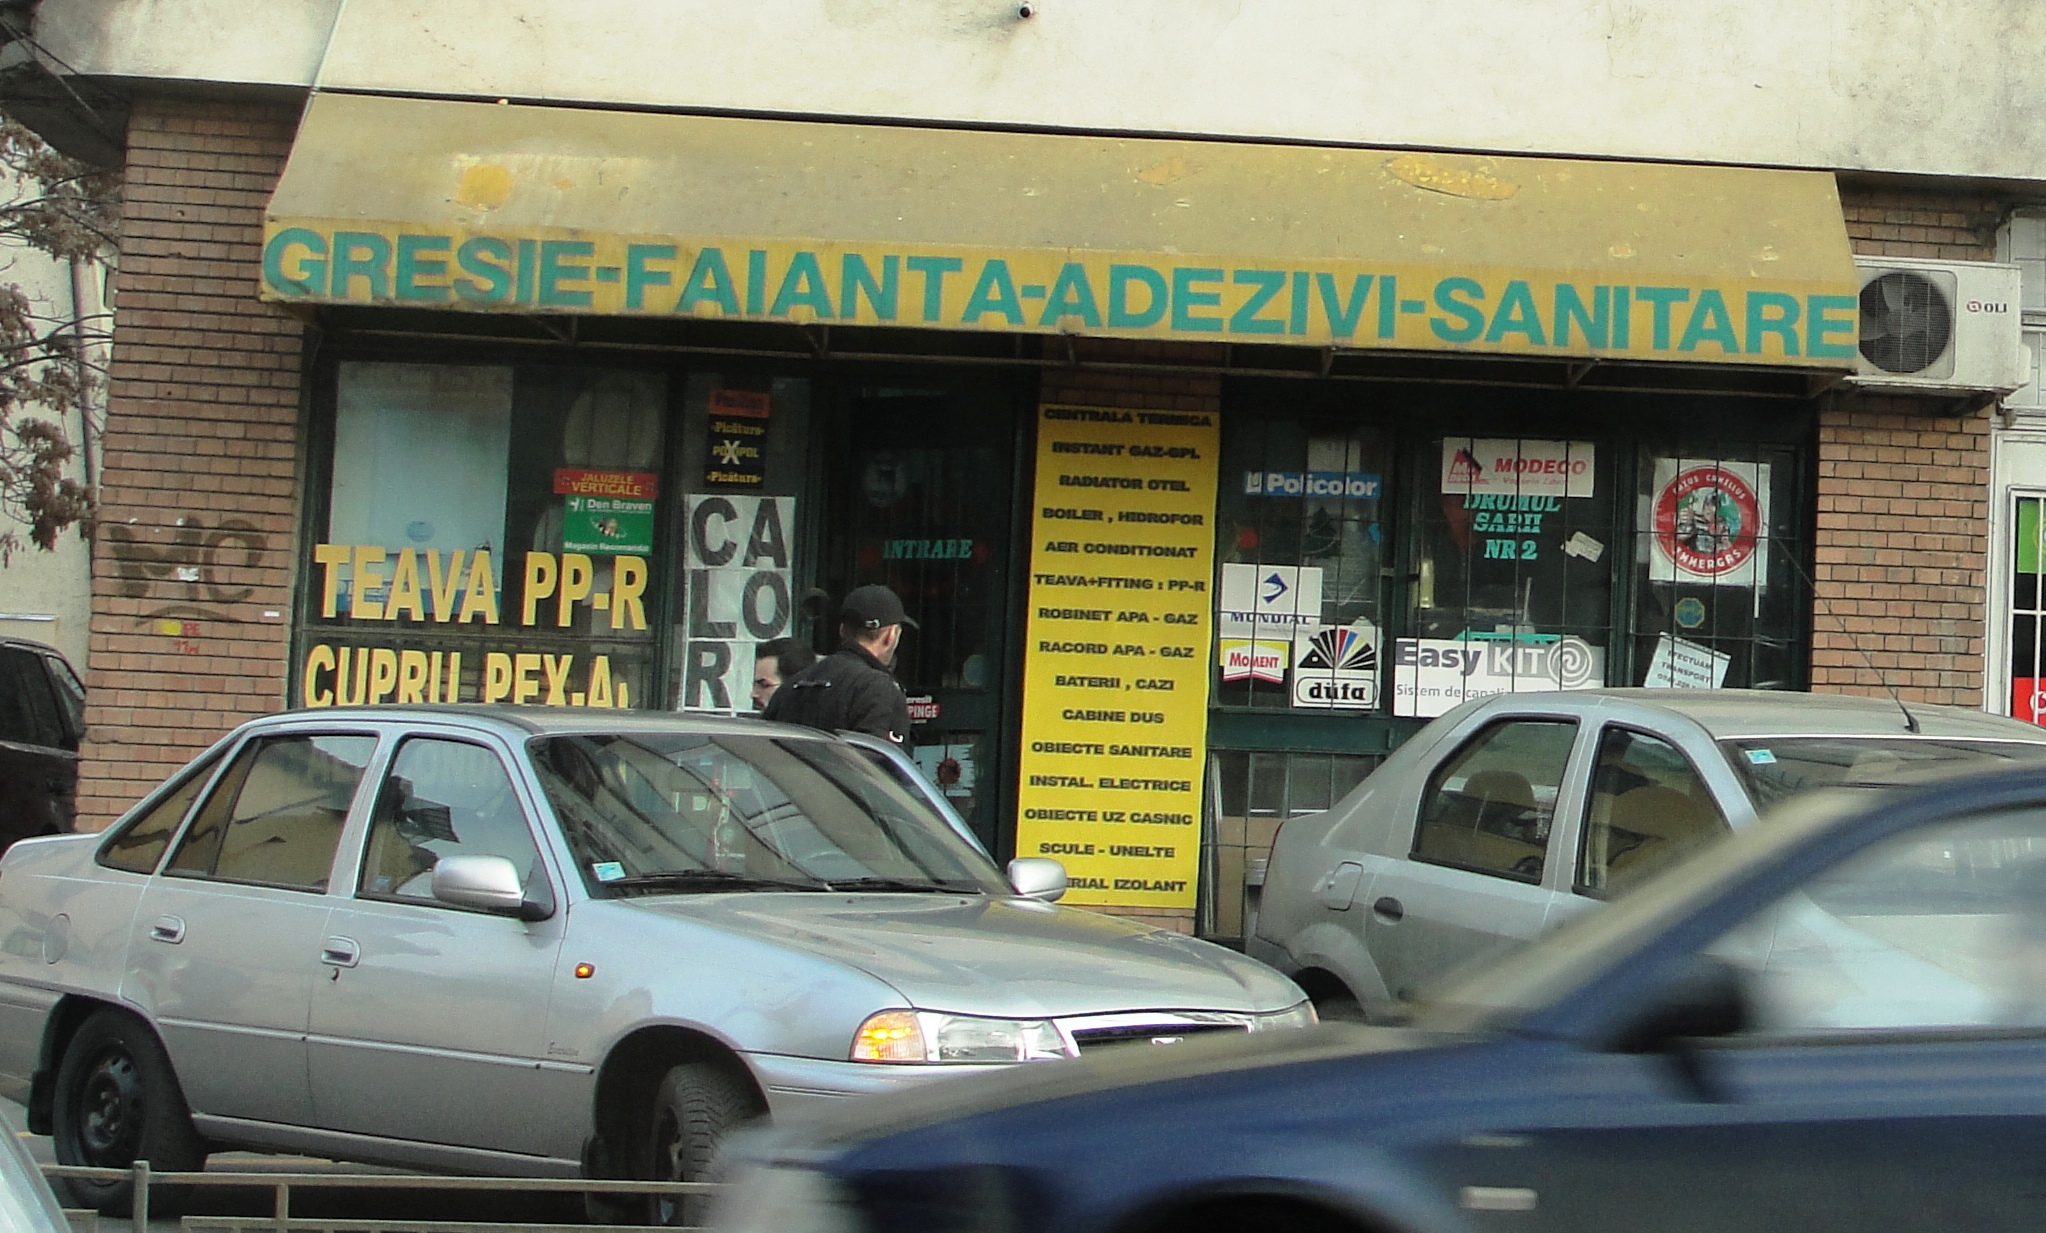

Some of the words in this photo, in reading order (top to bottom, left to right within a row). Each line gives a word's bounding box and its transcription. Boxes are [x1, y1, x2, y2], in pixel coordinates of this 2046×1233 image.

[262, 227, 1858, 358] GRESIE-FAIANTA-ADEZIVI-SANITARE
[1052, 442, 1126, 456] INSTANT
[1494, 458, 1587, 475] MODECO
[581, 473, 634, 485] JALUZELE
[1059, 475, 1143, 490] RADIATOR
[1148, 479, 1190, 492] OTEL
[1267, 473, 1377, 496] Policolor
[571, 481, 642, 495] VERTICALE
[1042, 508, 1104, 521] BOILER
[1118, 512, 1204, 526] HIDROFOR
[882, 539, 972, 559] INTRARE
[1045, 541, 1079, 554] AER
[1084, 543, 1198, 558] CONDITIONAT
[1484, 539, 1516, 560] NR
[1521, 540, 1539, 560] 2
[314, 543, 499, 625] TEAVA
[521, 550, 648, 631] PP-R
[1034, 574, 1153, 590] TEAVA+FITING
[1168, 580, 1205, 592] PP-R
[1039, 608, 1112, 621] ROBINET
[1117, 611, 1149, 623] APA
[1164, 613, 1198, 625] GAZ
[1039, 641, 1108, 654] RACORD
[1113, 644, 1145, 656] APA
[1160, 646, 1195, 658] GAZ
[1495, 646, 1545, 675] KIT
[1055, 675, 1121, 689] BATERII
[1135, 678, 1175, 690] CAZI
[1396, 684, 1440, 697] Sistem
[1445, 685, 1460, 697] de
[1062, 709, 1126, 722] CABINE
[1130, 712, 1165, 724] DUS
[1031, 742, 1104, 755] OBIECTE
[1109, 745, 1192, 758] SANITARE
[1029, 775, 1094, 789] INSTAL.
[1099, 778, 1191, 791] ELECTRICE
[1024, 809, 1098, 822] OBIECTE
[1102, 811, 1126, 823] UZ
[1130, 813, 1193, 825] CASNIC
[1039, 843, 1095, 855] SCULE
[1109, 845, 1175, 858] UNELTE
[1066, 877, 1109, 889] ERIAL
[1114, 879, 1187, 892] IZOLANT
